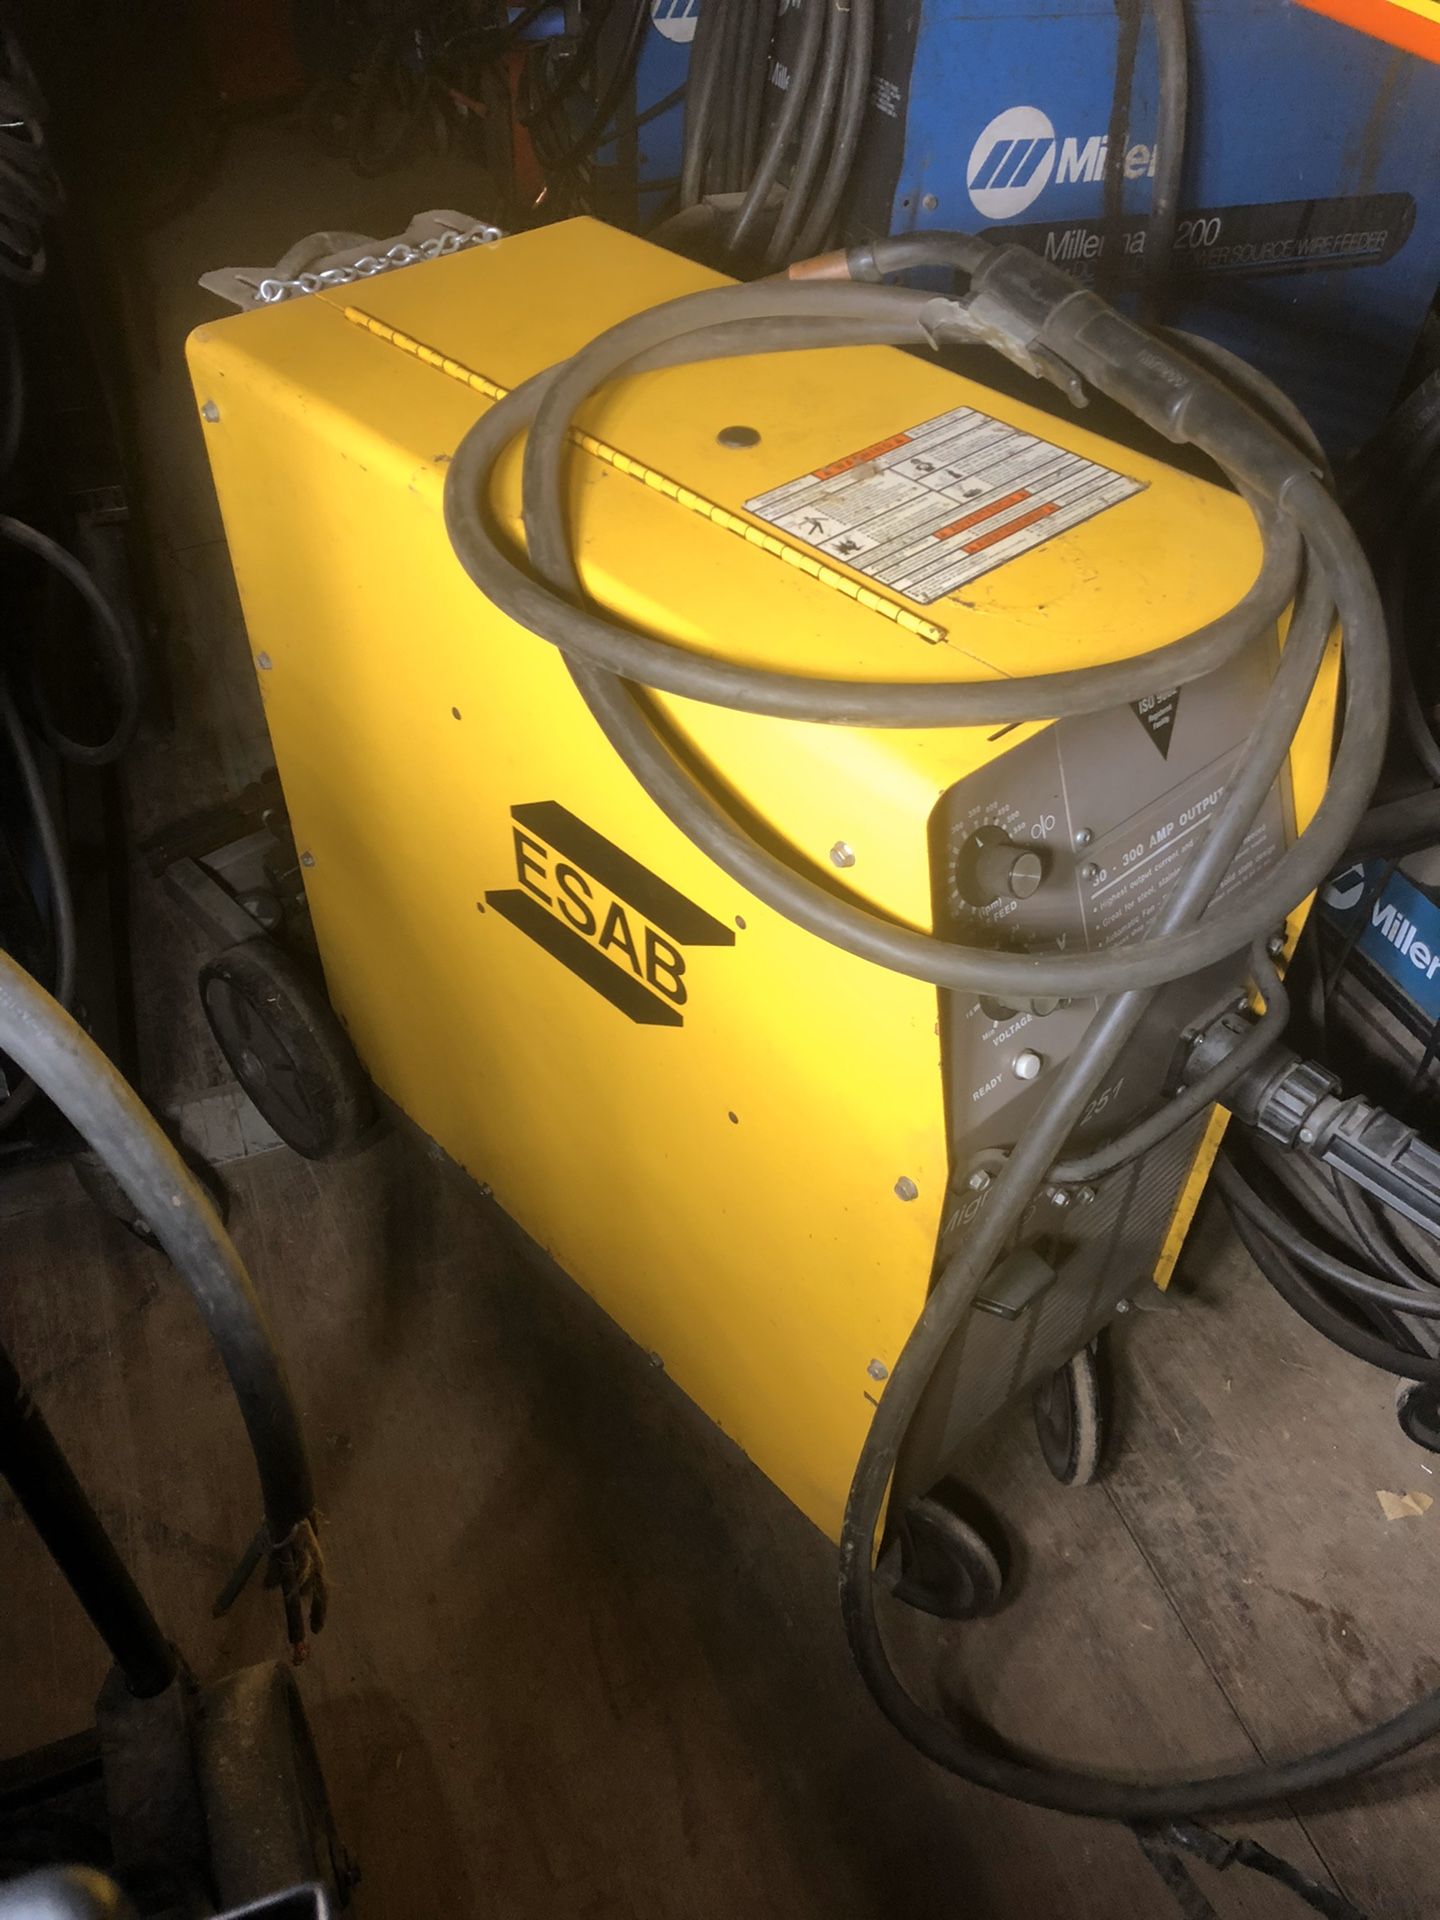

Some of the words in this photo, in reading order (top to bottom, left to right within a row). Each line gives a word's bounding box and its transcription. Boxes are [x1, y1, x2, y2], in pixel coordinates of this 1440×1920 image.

[1121, 844, 1144, 868] 300
[1150, 822, 1175, 849] AMP
[1179, 785, 1225, 827] OUTPUT
[511, 825, 688, 1006] ESAB
[993, 900, 1018, 923] FEED
[992, 1012, 1033, 1047] VOLTAGE
[972, 1073, 1004, 1102] READY
